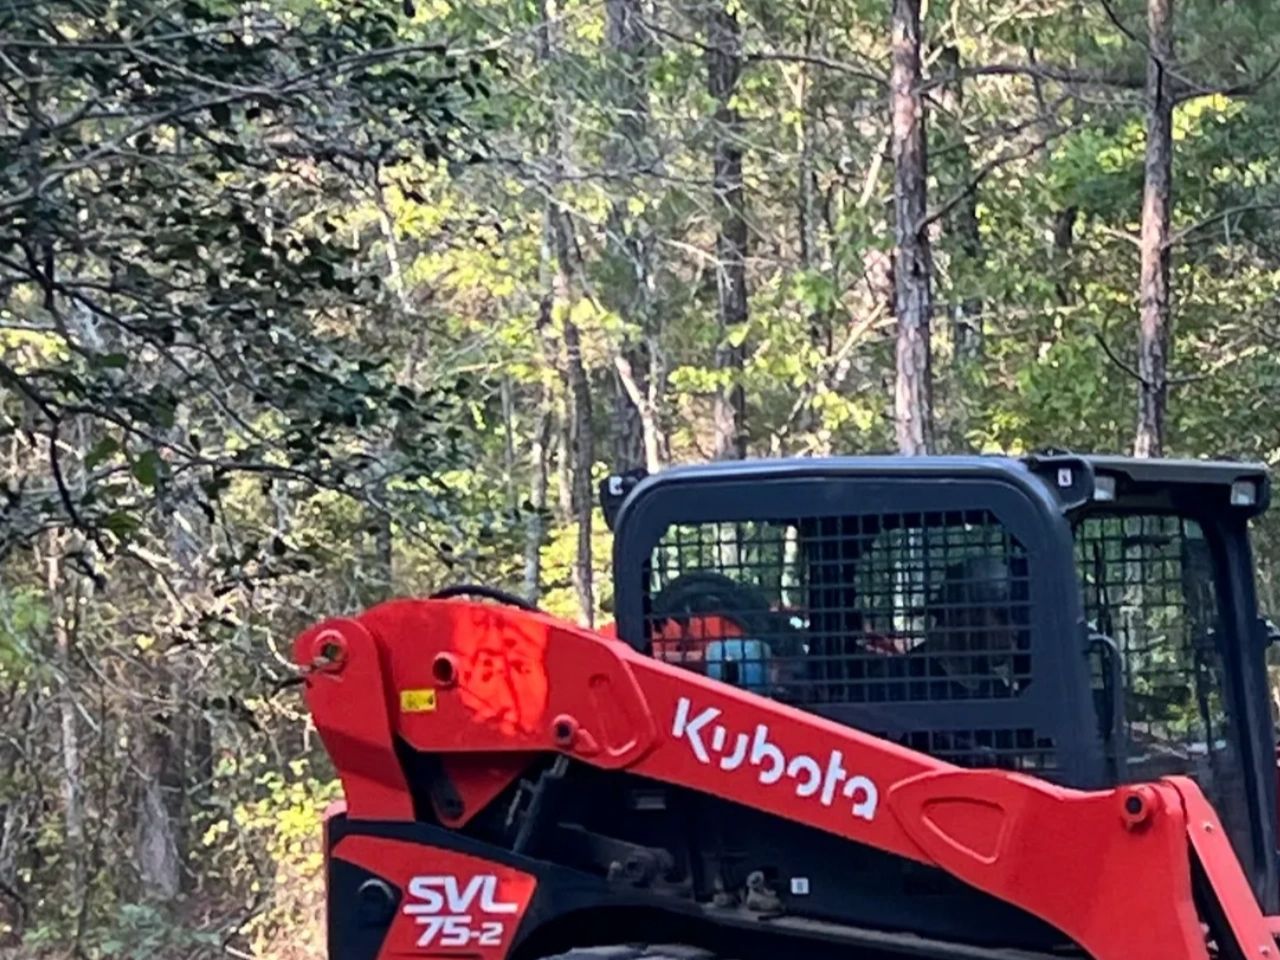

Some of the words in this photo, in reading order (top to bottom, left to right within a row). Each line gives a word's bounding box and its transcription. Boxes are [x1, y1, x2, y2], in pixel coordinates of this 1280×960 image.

[672, 697, 878, 821] Kubota
[403, 874, 518, 914] SVL
[415, 915, 503, 947] 75-2
